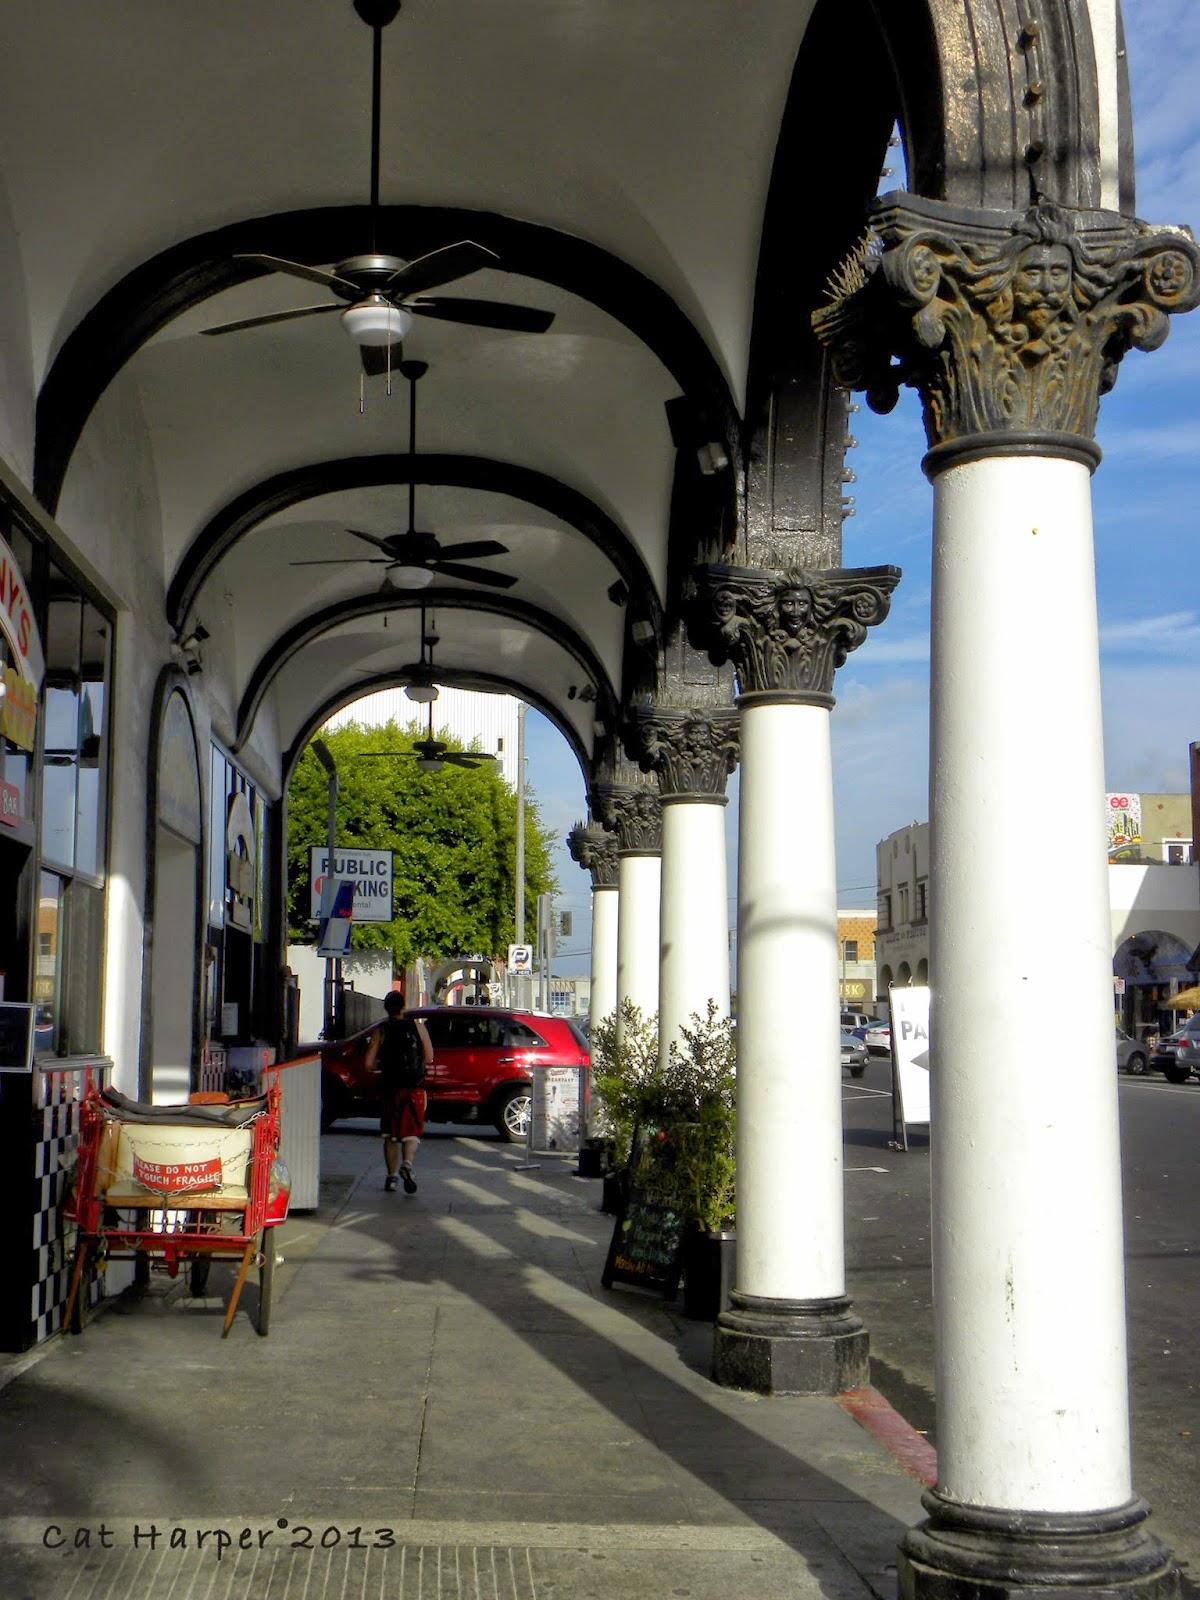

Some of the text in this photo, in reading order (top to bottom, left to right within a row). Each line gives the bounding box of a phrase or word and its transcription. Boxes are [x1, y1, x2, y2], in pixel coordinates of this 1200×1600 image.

[321, 858, 387, 876] PUBLIC
[901, 1020, 928, 1040] PA
[138, 1169, 169, 1185] TOUCH
[165, 1166, 179, 1174] DO
[184, 1164, 208, 1173] NOT
